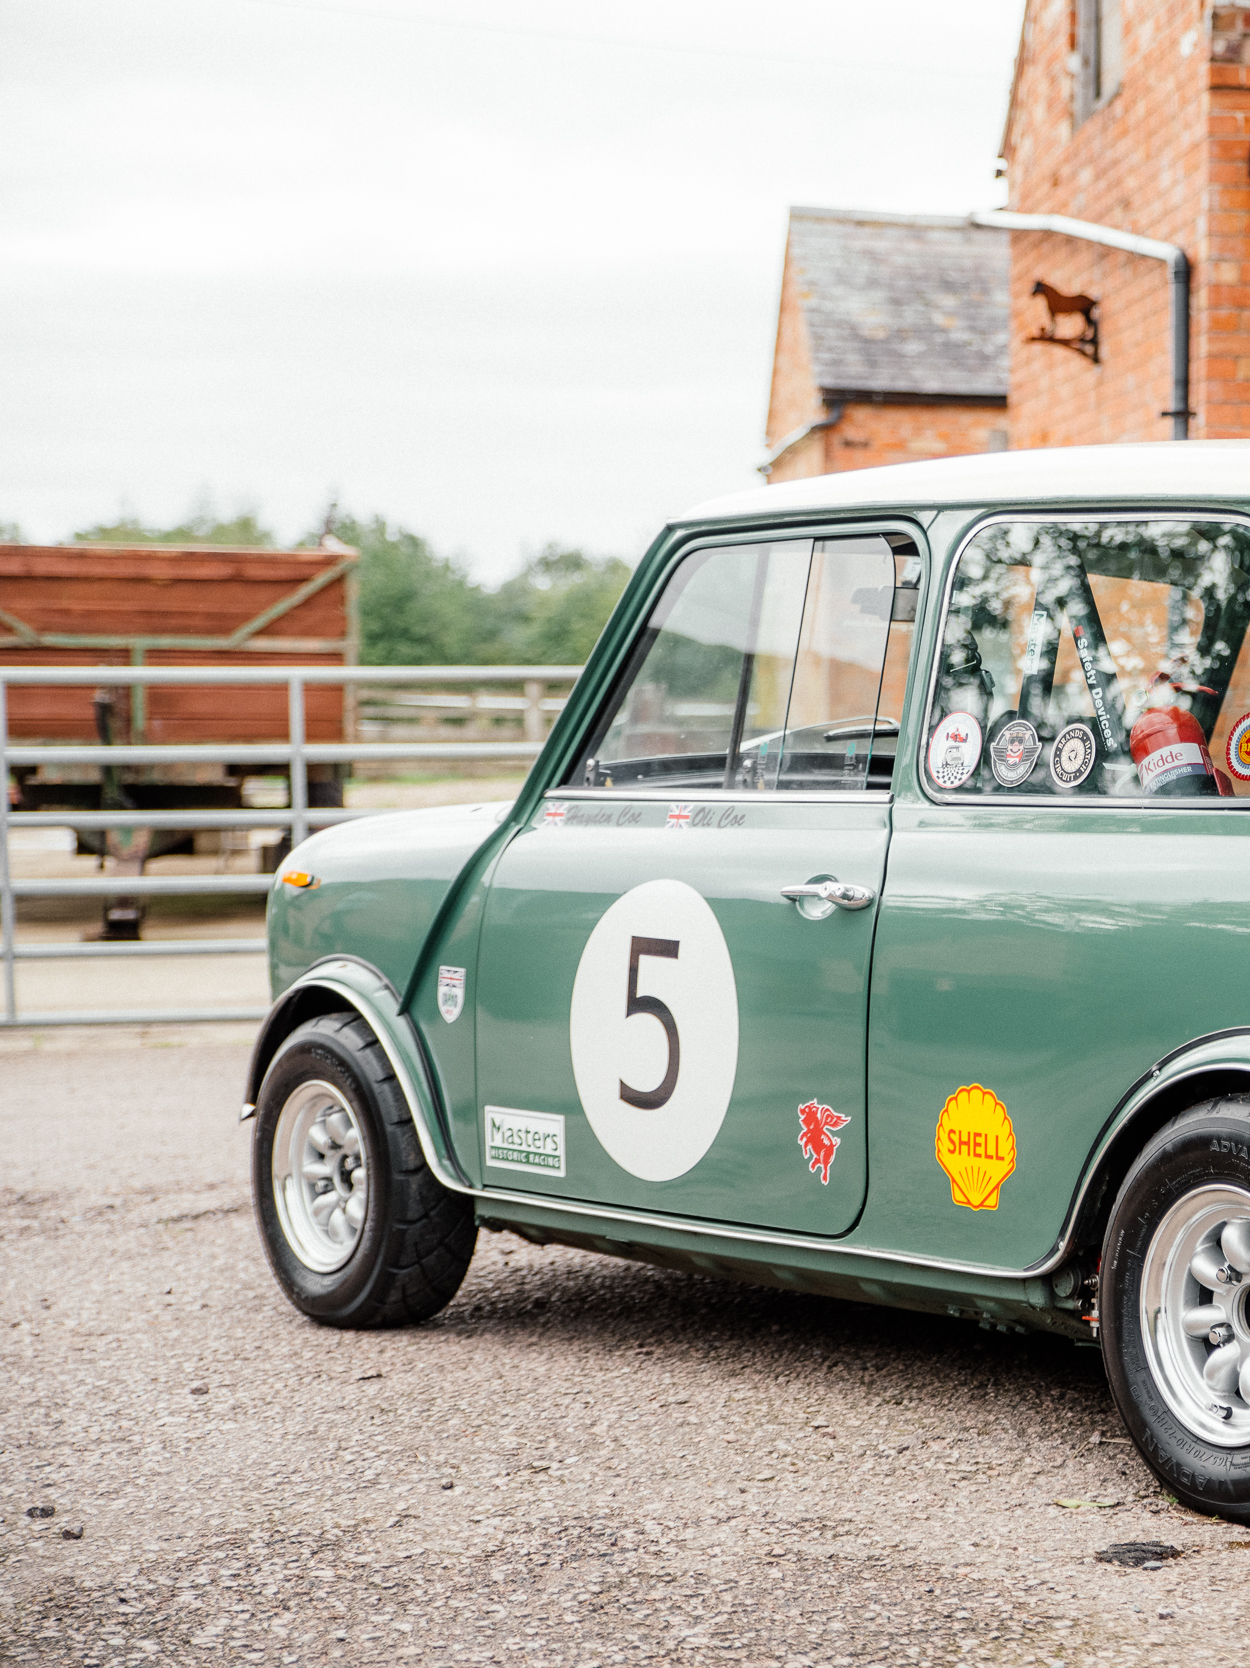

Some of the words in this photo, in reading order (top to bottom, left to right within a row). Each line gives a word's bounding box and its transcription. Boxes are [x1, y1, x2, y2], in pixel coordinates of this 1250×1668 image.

[1077, 638, 1096, 685] Safety
[1058, 729, 1084, 750] BRANDS
[1054, 758, 1076, 782] CIRCUIT
[1080, 740, 1092, 773] HATCH
[1144, 750, 1184, 777] Kidde
[616, 804, 643, 827] Coe
[692, 806, 714, 827] Oli
[717, 806, 746, 829] Coe
[619, 935, 681, 1111] 5
[490, 1116, 559, 1152] Masters
[947, 1128, 1005, 1161] SHELL
[490, 1146, 527, 1163] HISTORIC
[529, 1154, 560, 1168] RACING
